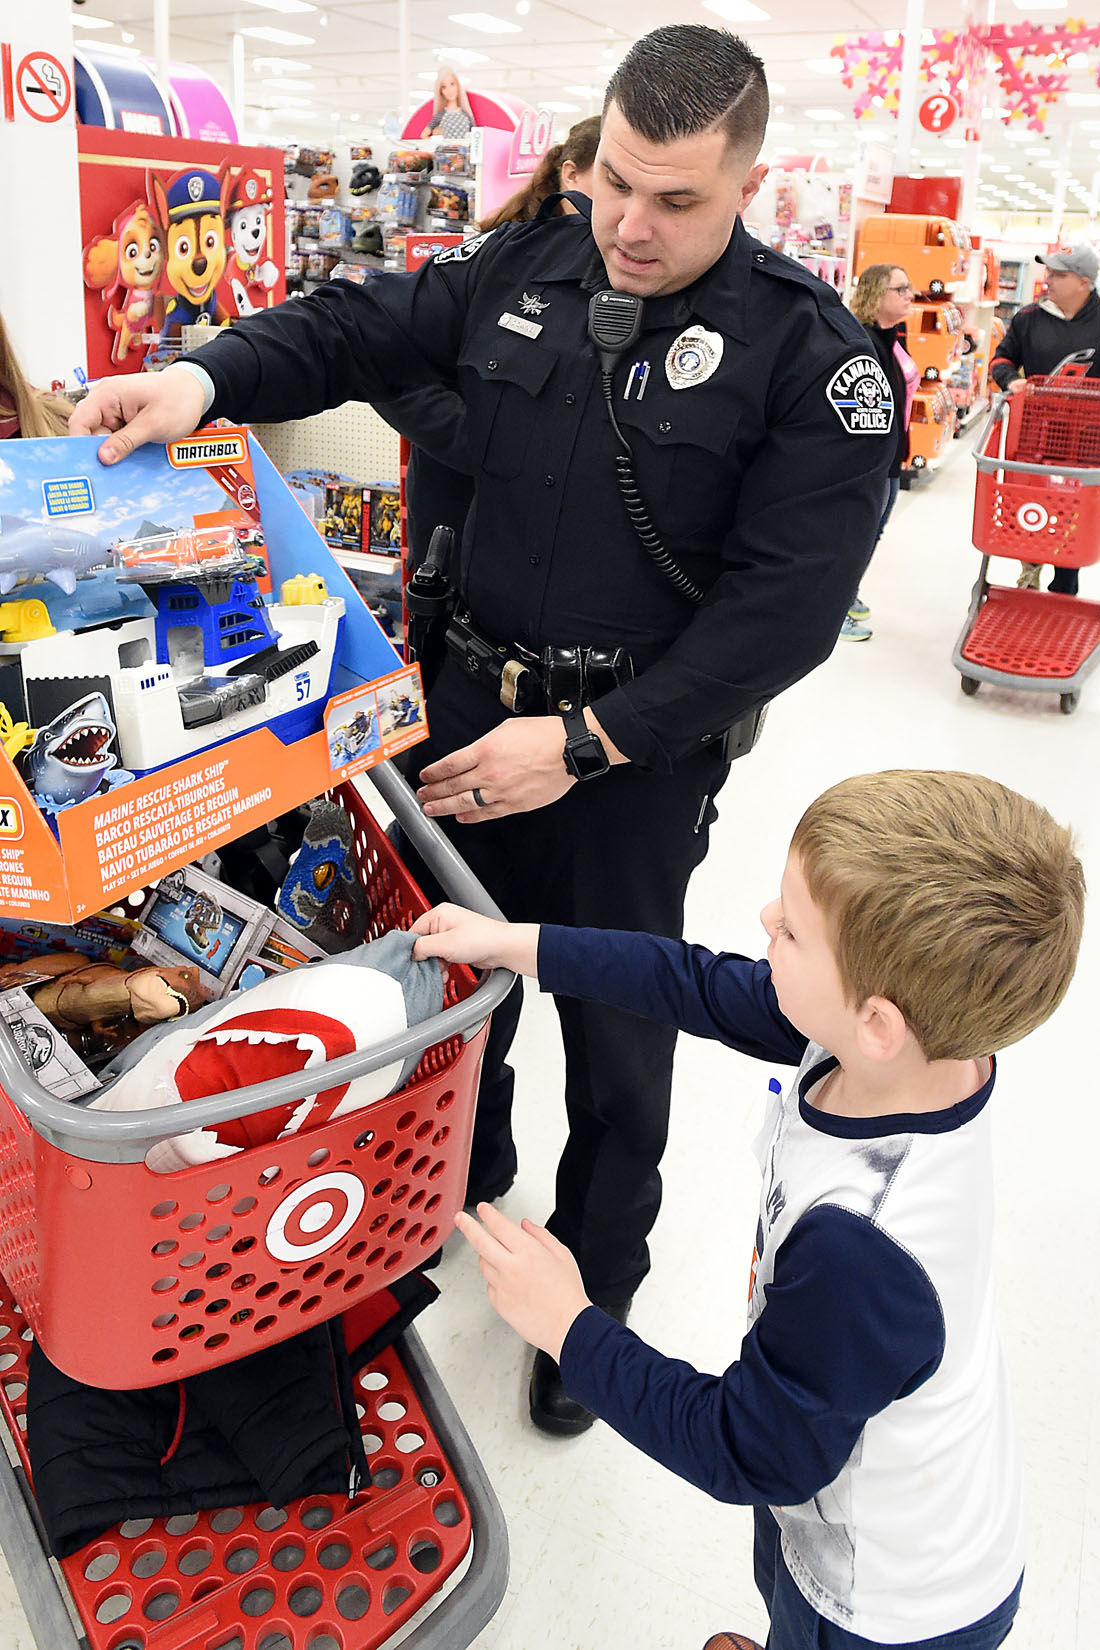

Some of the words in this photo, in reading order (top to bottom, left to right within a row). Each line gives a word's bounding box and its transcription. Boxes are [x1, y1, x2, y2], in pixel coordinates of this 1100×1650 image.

[851, 413, 887, 428] POLICE
[176, 443, 238, 460] MATCHBOX
[296, 679, 310, 701] 57
[94, 800, 134, 830] MARINE
[136, 784, 172, 811] RESCUE
[172, 770, 204, 795] SHARK
[95, 820, 131, 848] BARCO
[133, 777, 225, 830] RESCATA-TIBURONES
[97, 834, 138, 865] BATEAU
[139, 809, 193, 845] SAUVETAGE
[193, 802, 206, 819] DE
[206, 786, 239, 812] REQUIN
[100, 854, 134, 882] NAVIO
[135, 831, 181, 864] TUBARÃO
[181, 824, 195, 841] DE
[195, 806, 232, 835] RESGATE
[232, 787, 272, 816] MARINHO
[0, 861, 24, 873] RONES
[102, 882, 116, 893] PLAY
[116, 876, 126, 886] SET
[130, 868, 139, 879] SET
[140, 865, 147, 874] DE
[147, 856, 164, 870] JUEGO
[167, 844, 188, 860] COFFRET
[188, 841, 195, 850] DE
[195, 836, 204, 847] JEU
[207, 822, 231, 840] CONJUNTO
[1, 874, 32, 887] REQUIN
[11, 887, 50, 902] MARINHO
[76, 904, 86, 913] 3+
